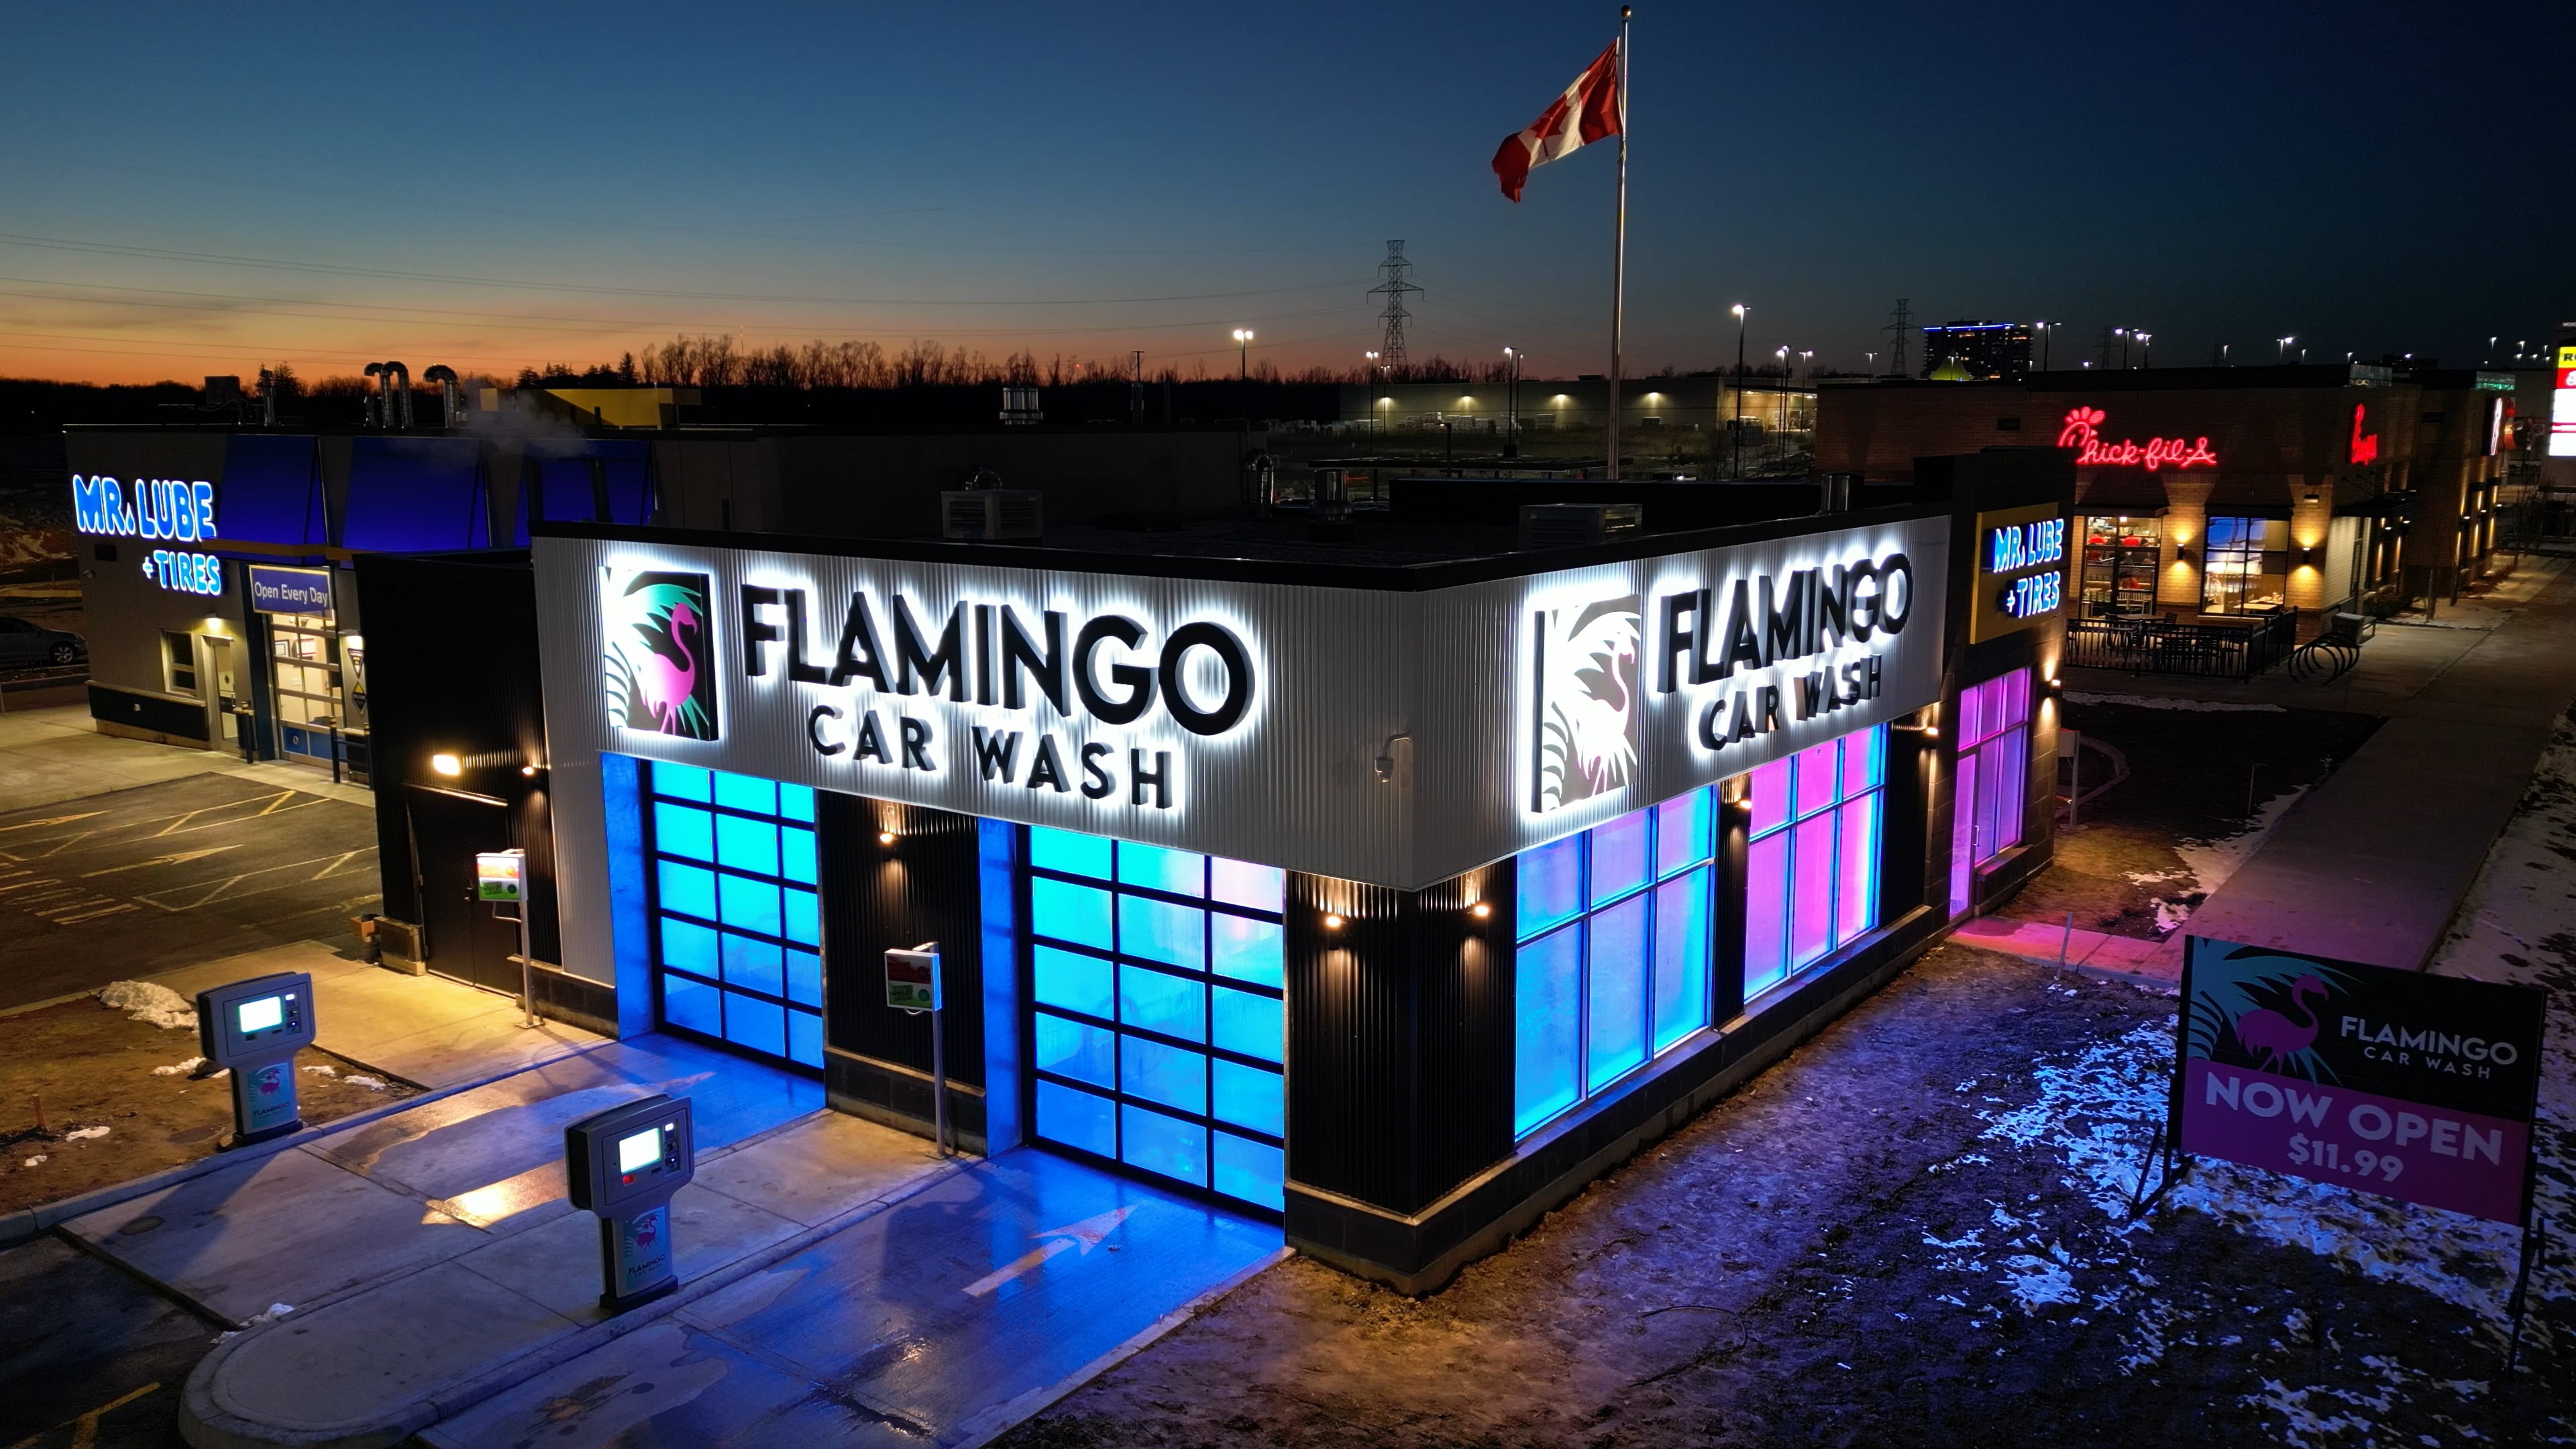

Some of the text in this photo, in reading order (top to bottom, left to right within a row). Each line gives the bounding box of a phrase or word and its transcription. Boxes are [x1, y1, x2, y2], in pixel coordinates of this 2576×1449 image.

[72, 474, 216, 542] MR. LUBE
[1993, 518, 2064, 574] MR. LUBE
[254, 581, 327, 607] Open Every Day
[1657, 553, 1913, 694] FLAMINGO
[742, 584, 1256, 737] FLAMINGO
[1699, 653, 1882, 751] CAR WASH
[808, 704, 1173, 809] CAR WASH
[2341, 1016, 2518, 1065] FLAMINGO
[2364, 1046, 2491, 1079] CAR WASH
[2206, 1071, 2503, 1167] NOW OPEN
[2288, 1132, 2404, 1183] $11.99
